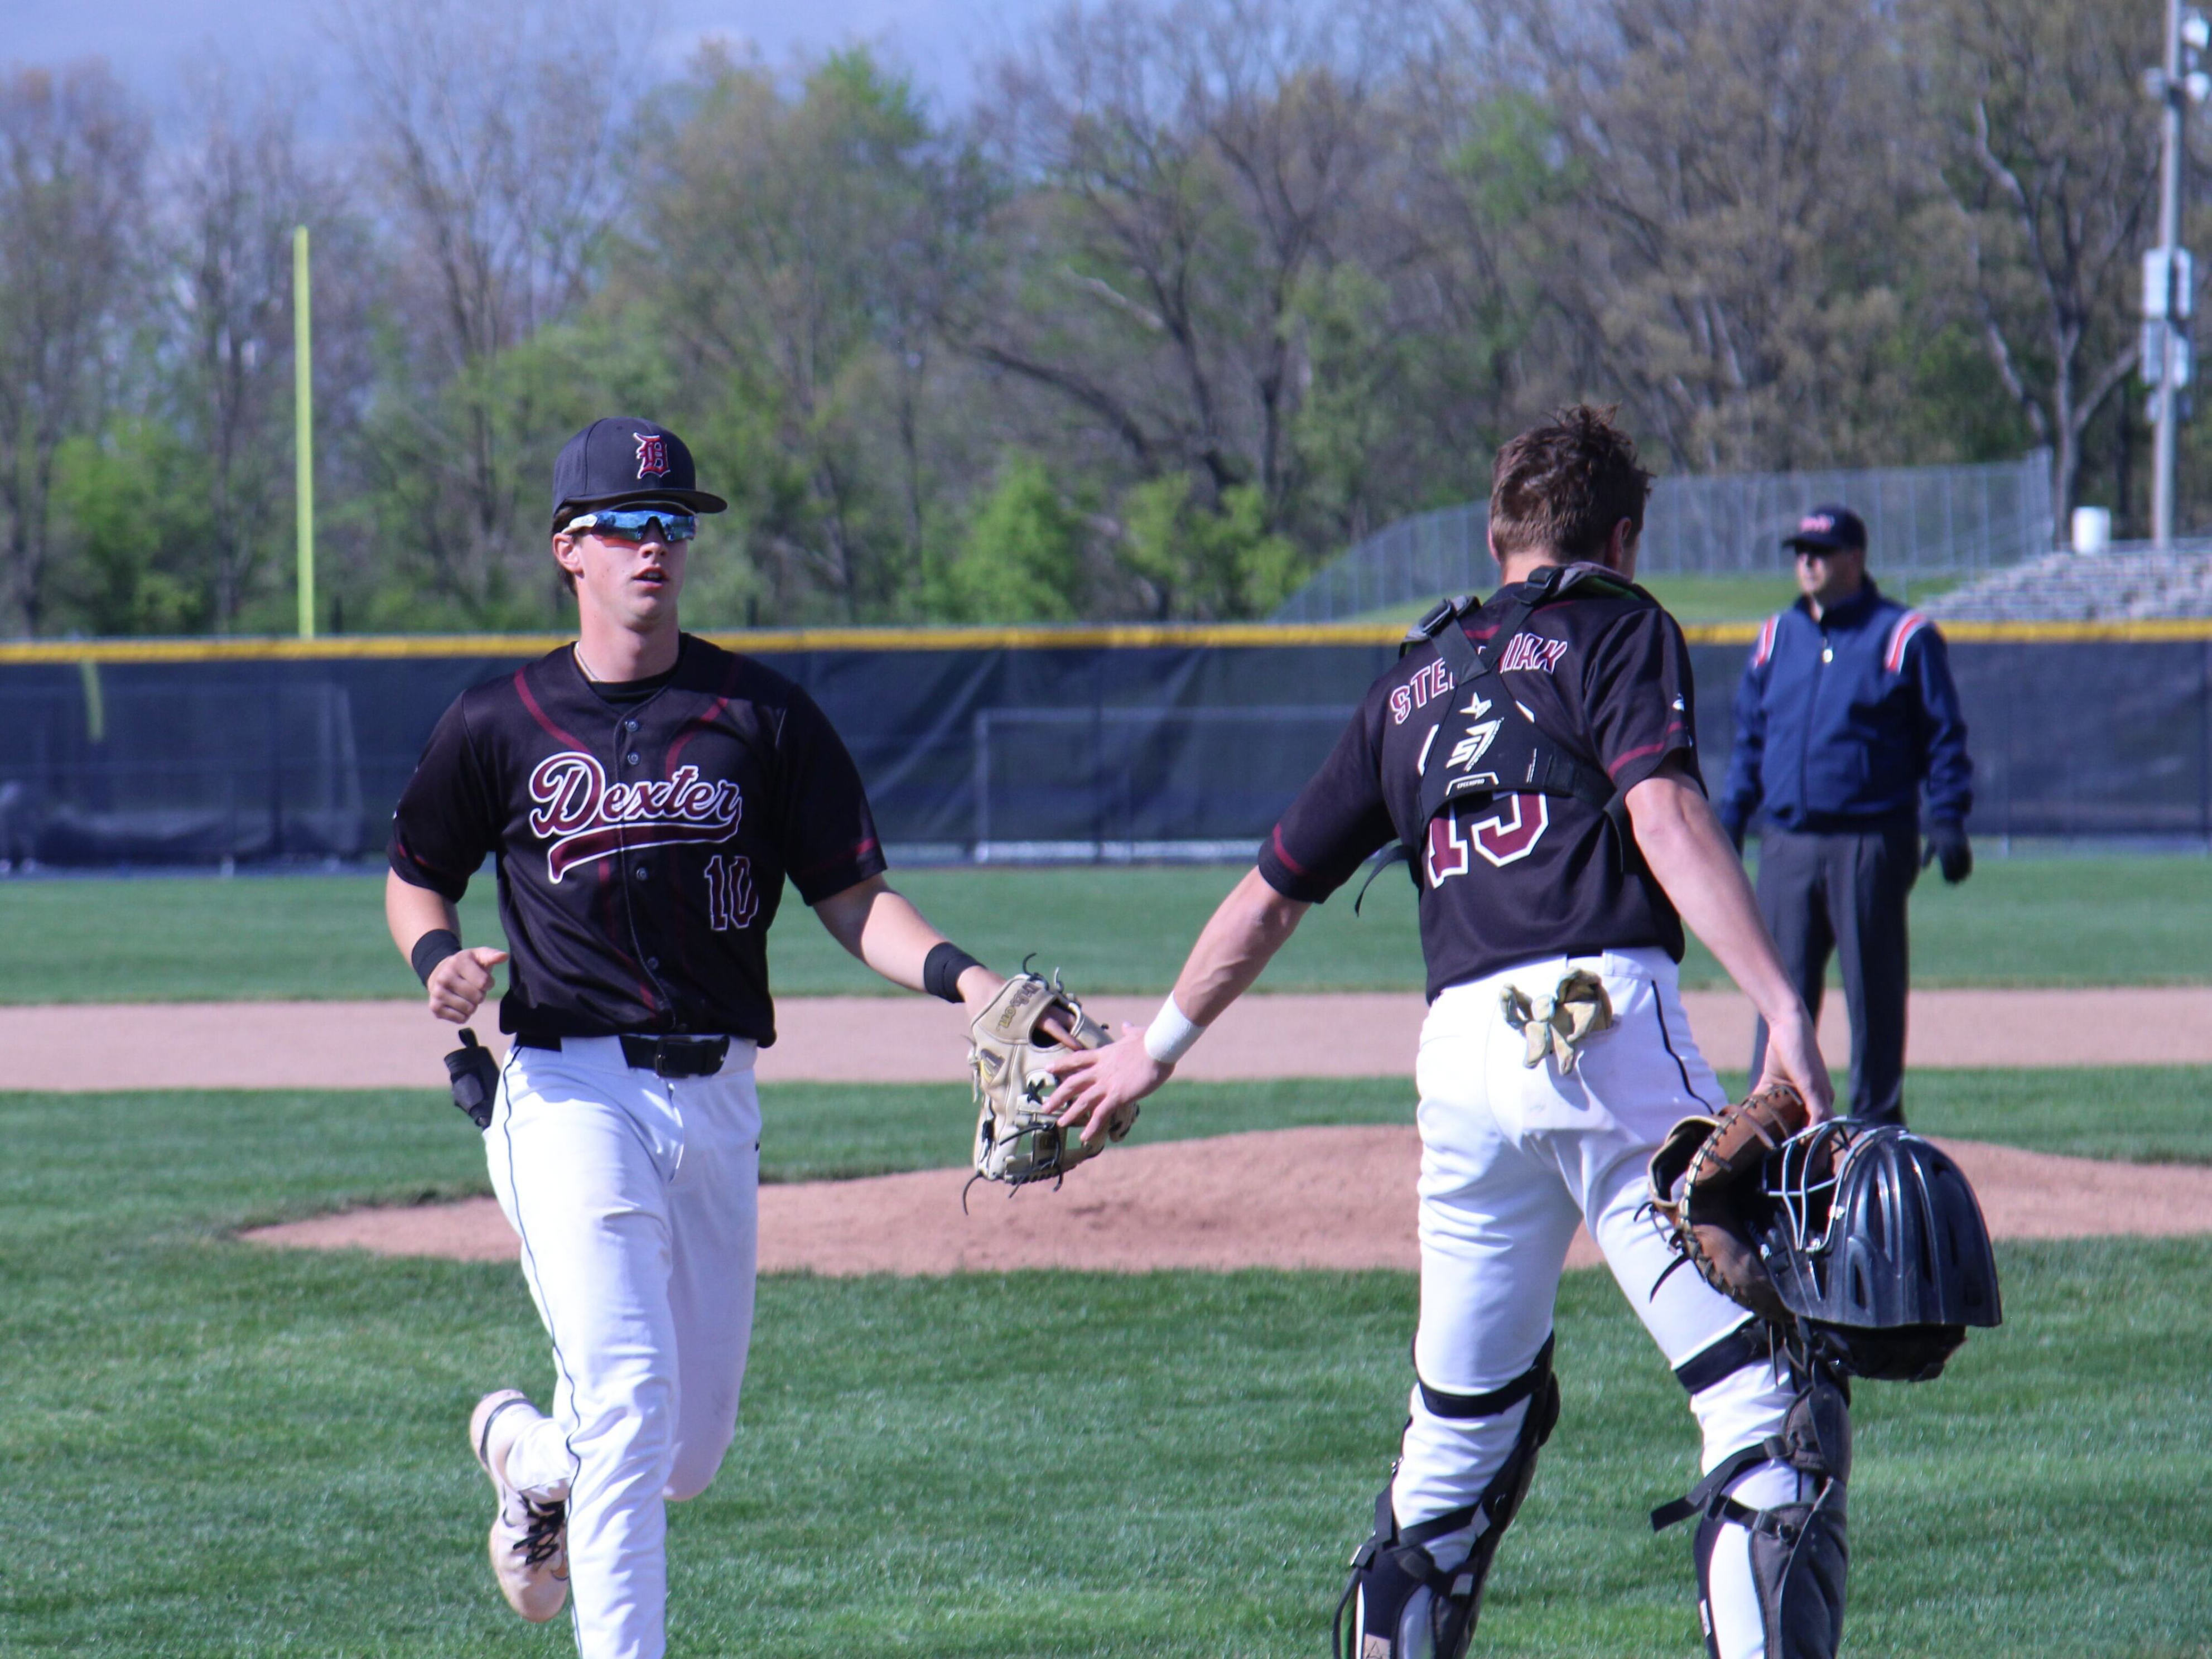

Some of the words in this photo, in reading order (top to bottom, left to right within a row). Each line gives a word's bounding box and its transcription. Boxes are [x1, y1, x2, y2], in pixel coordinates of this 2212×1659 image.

[633, 432, 671, 480] D
[529, 751, 741, 838] Dexter
[703, 855, 759, 930] 10
